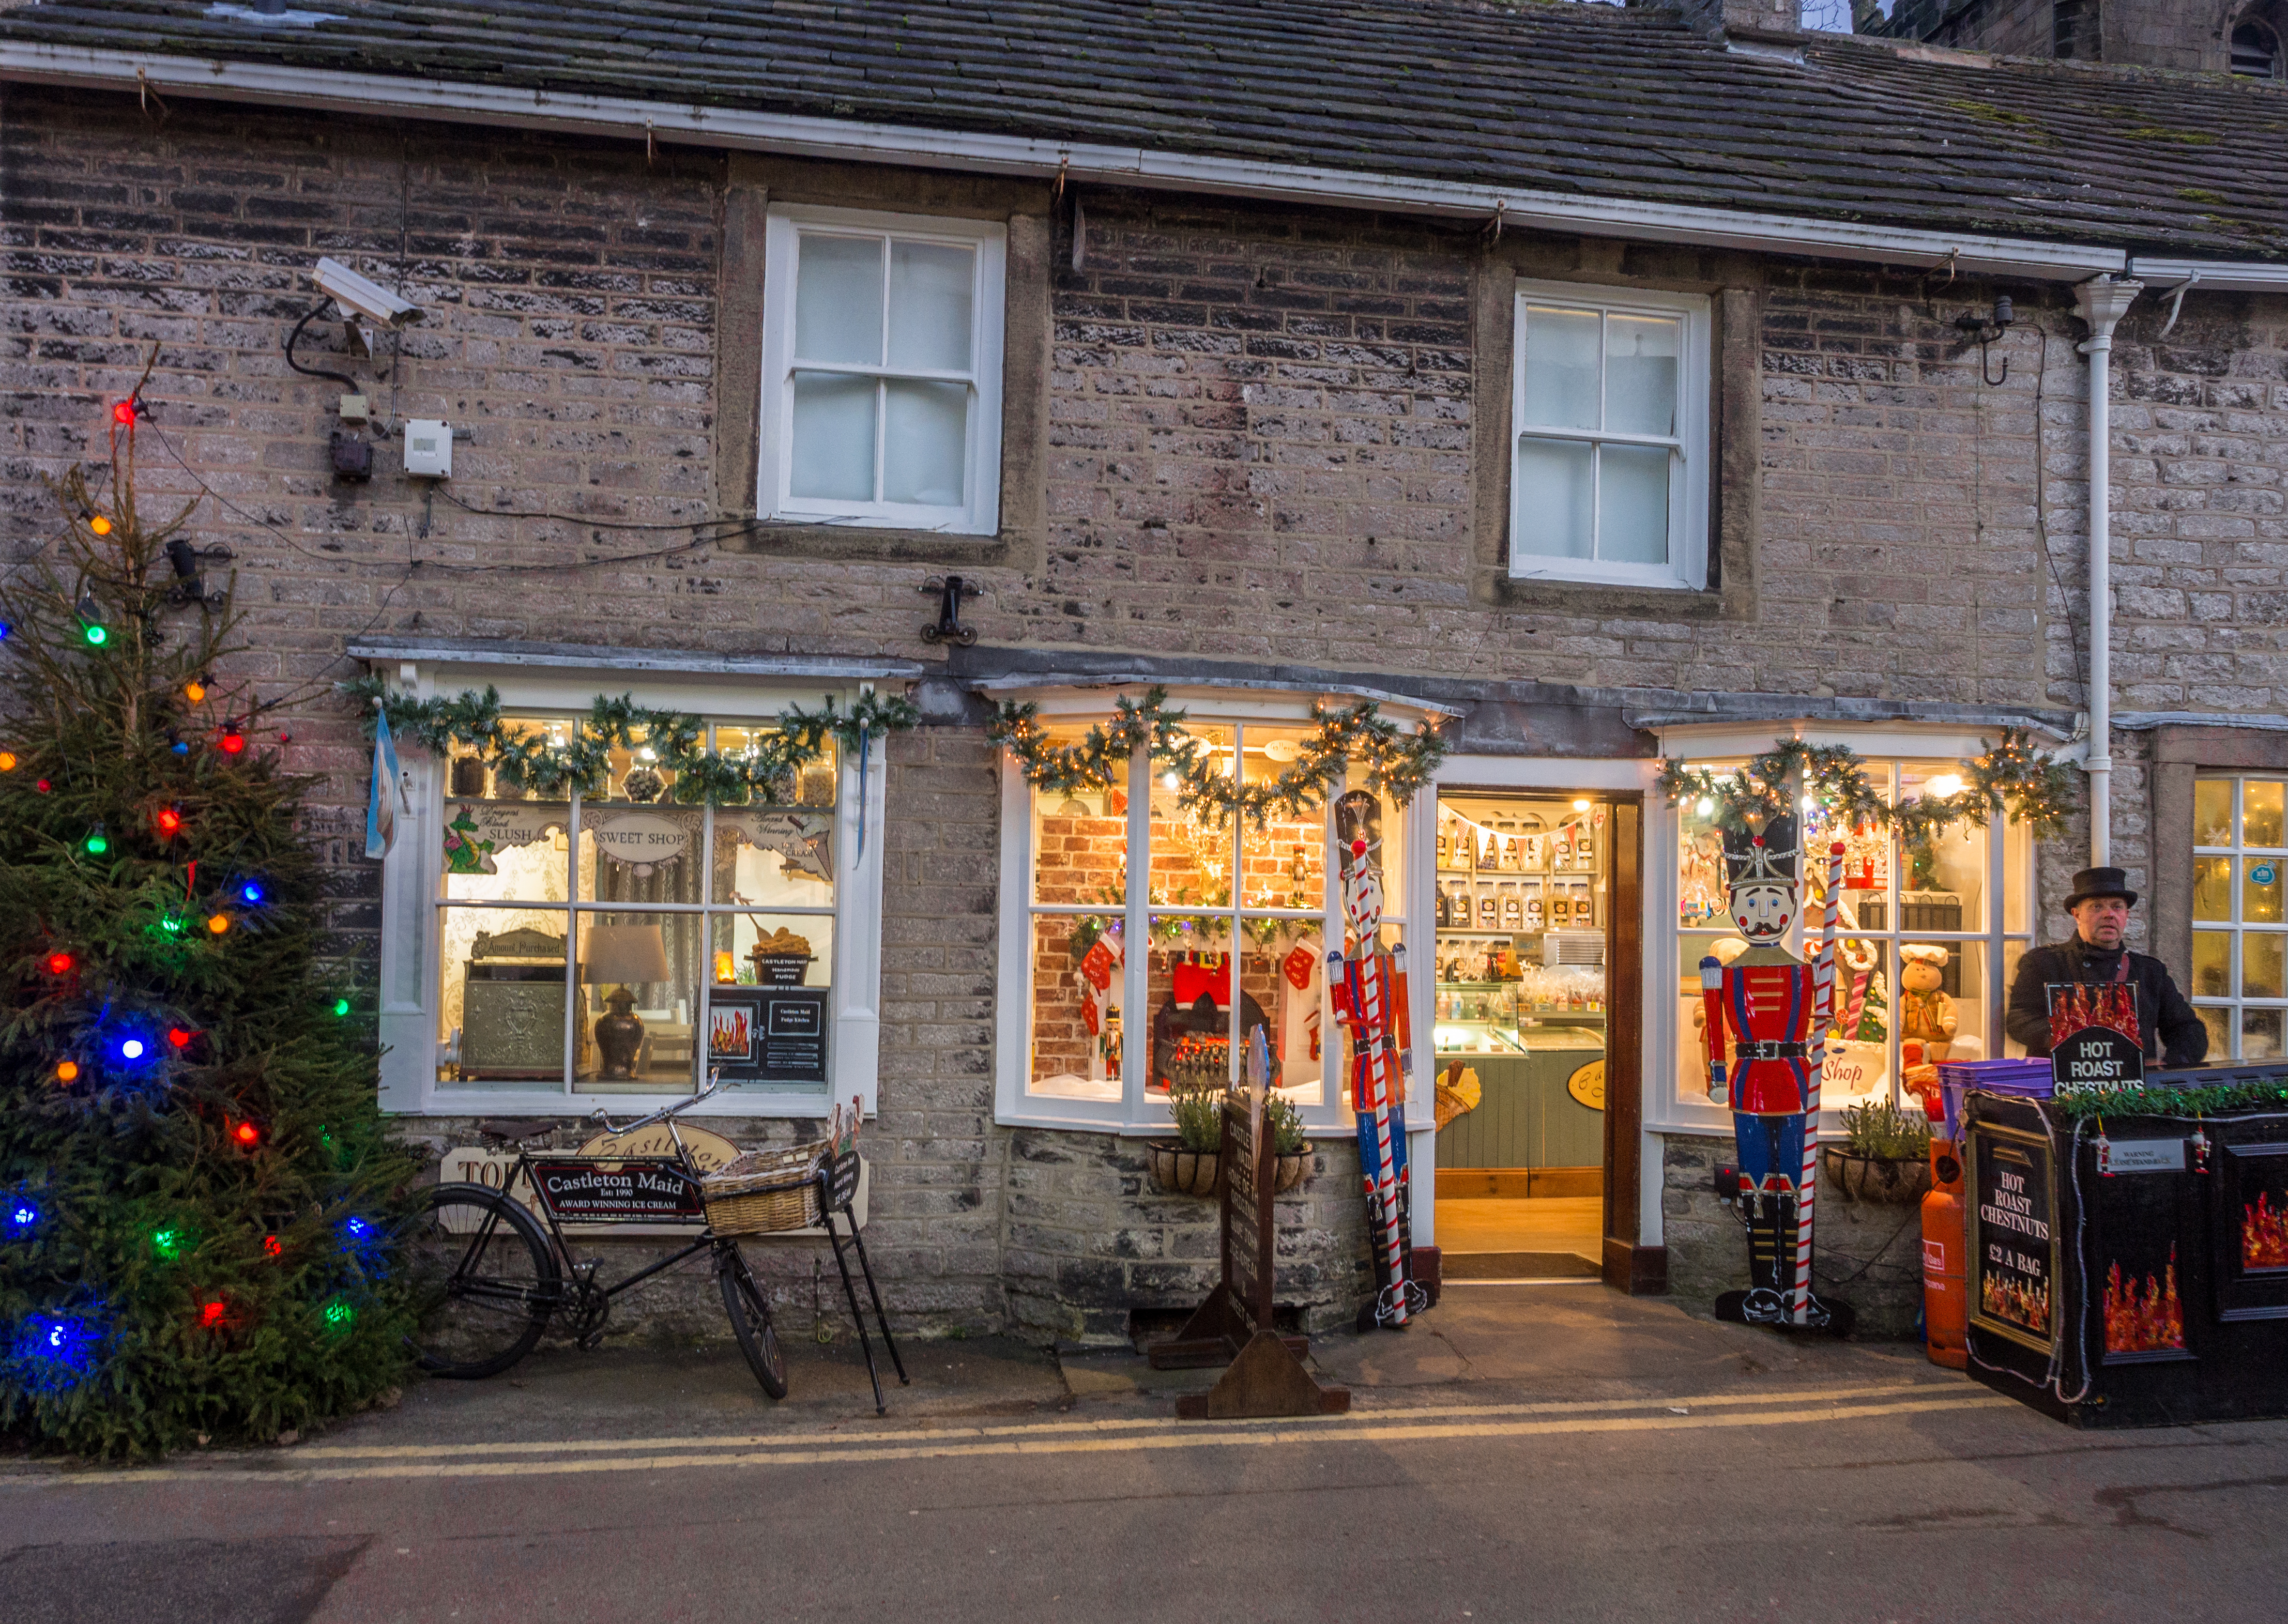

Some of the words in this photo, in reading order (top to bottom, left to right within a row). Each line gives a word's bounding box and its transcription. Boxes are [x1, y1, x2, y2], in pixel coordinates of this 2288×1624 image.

[480, 805, 519, 817] Dragons
[490, 829, 532, 840] SLUSH
[599, 832, 643, 844] SWEET
[648, 833, 684, 845] SHOP
[756, 823, 794, 838] Winning
[785, 849, 813, 857] CREAM
[487, 942, 515, 953] Amount
[516, 941, 559, 954] Purchased
[2080, 1041, 2113, 1058] HOT
[1821, 1057, 1863, 1091] Shop
[2070, 1060, 2124, 1077] ROAST
[1230, 1121, 1252, 1151] CASTLET
[547, 1171, 632, 1193] Castleton
[637, 1172, 683, 1195] Maid
[1228, 1166, 1241, 1191] HOME
[1242, 1178, 1249, 1196] OF
[2001, 1171, 2025, 1194] HOT
[616, 1188, 633, 1197] 1990
[1995, 1189, 2032, 1216] ROAST
[560, 1200, 590, 1208] AWARD
[593, 1200, 631, 1209] WINNING
[632, 1201, 646, 1209] ICE
[647, 1201, 677, 1209] CREAM
[1231, 1188, 1258, 1227] ORIGINAL
[1980, 1204, 2049, 1240] CHESTNUTS
[1230, 1238, 1239, 1261] ICE
[1989, 1244, 2002, 1263] £2
[2005, 1249, 2015, 1267] A
[2017, 1252, 2041, 1277] BAG
[1242, 1280, 1246, 1297] &
[1228, 1290, 1245, 1321] SWEET
[1246, 1312, 1257, 1336] SHO
